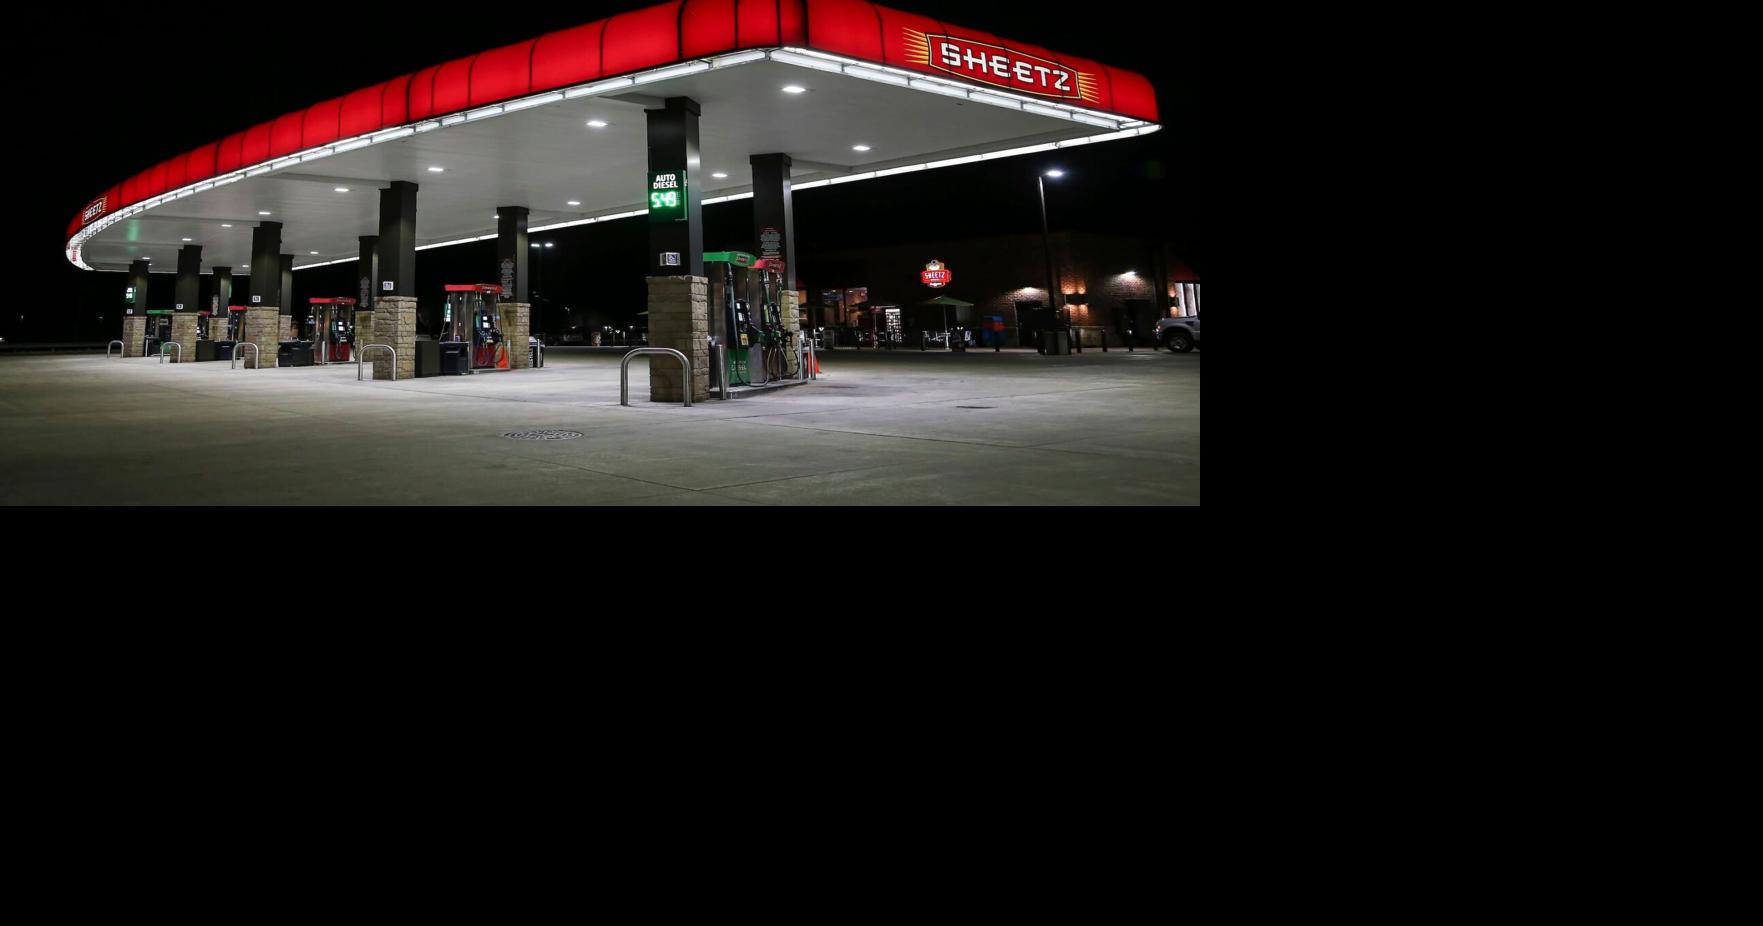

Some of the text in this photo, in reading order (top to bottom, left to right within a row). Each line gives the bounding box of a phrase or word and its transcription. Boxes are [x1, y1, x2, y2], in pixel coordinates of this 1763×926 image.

[941, 43, 1070, 91] SHEETZ
[656, 174, 676, 182] AUTO
[653, 181, 678, 189] DIESEL
[85, 201, 102, 221] SHEETZ
[925, 271, 945, 279] SHEETZ
